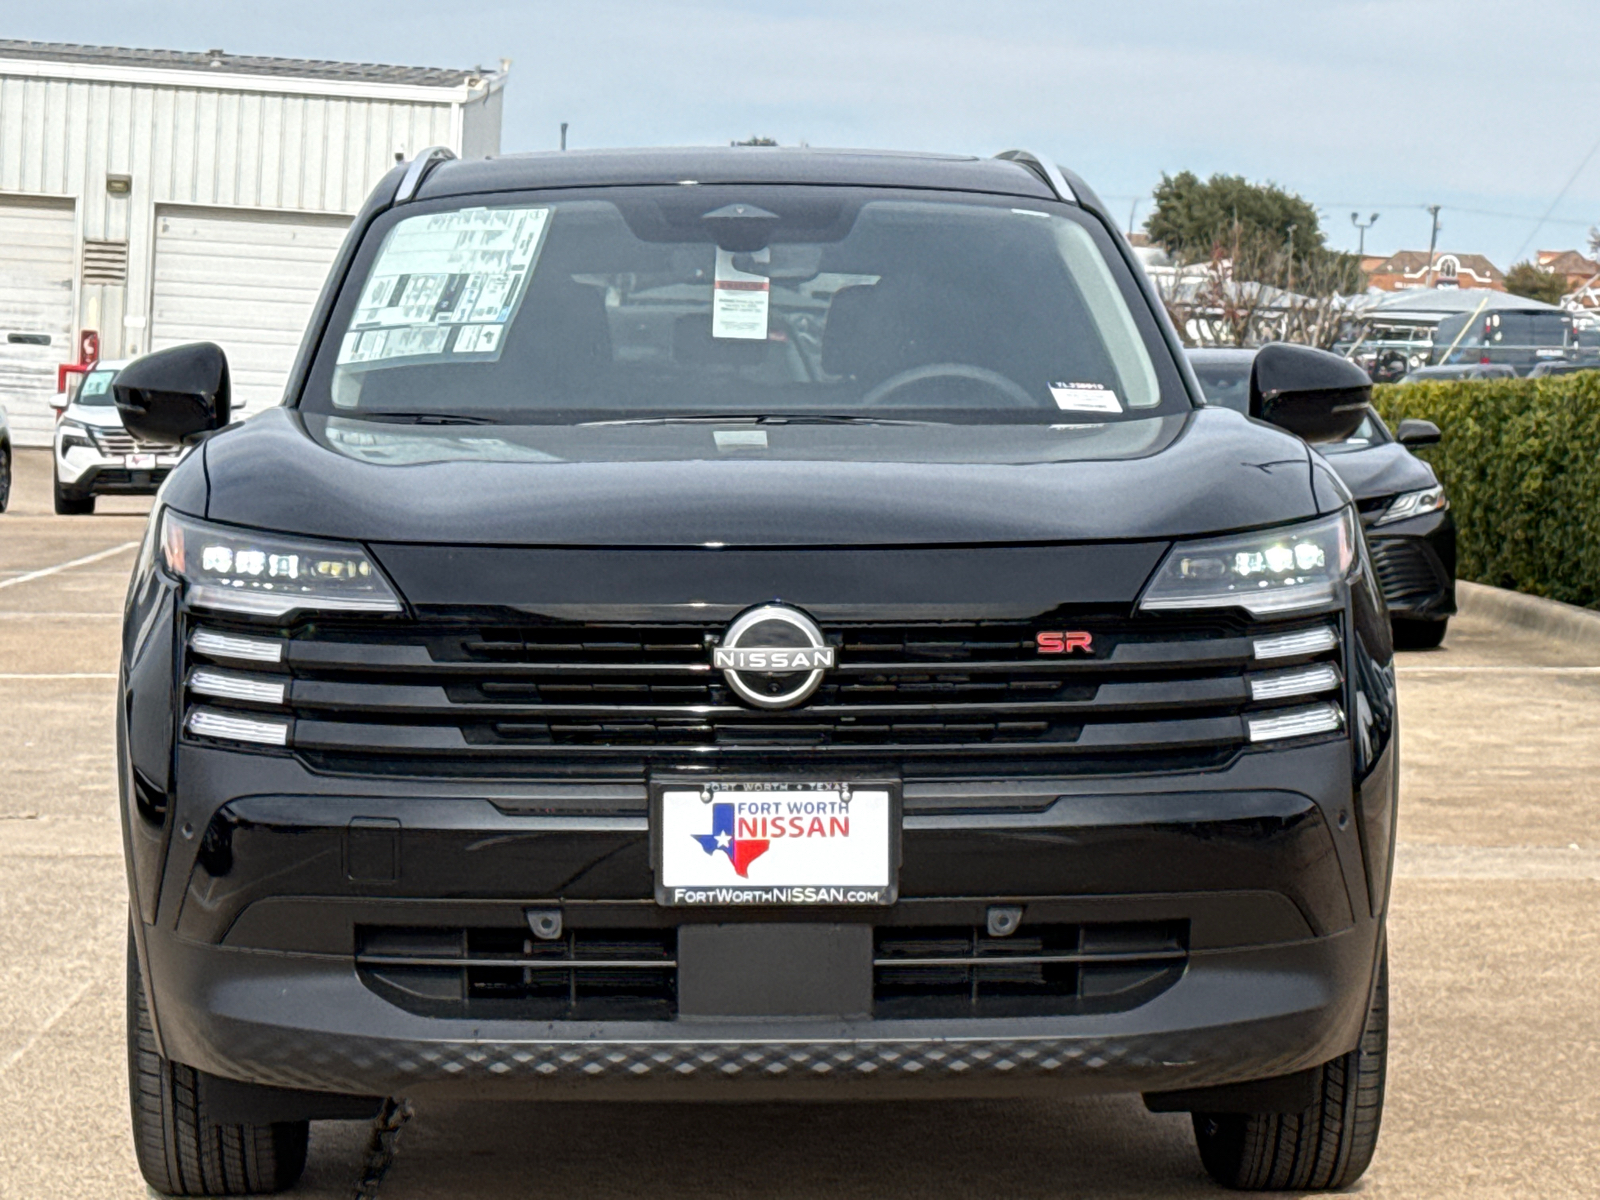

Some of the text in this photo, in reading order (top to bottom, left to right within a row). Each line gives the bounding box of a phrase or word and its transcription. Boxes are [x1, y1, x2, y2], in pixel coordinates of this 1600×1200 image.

[1036, 631, 1095, 653] SR
[716, 651, 832, 668] NISSAN
[704, 782, 849, 792] FORT WORTH TEXAS
[738, 802, 849, 815] FORT WORTH
[738, 816, 850, 838] NISSAN
